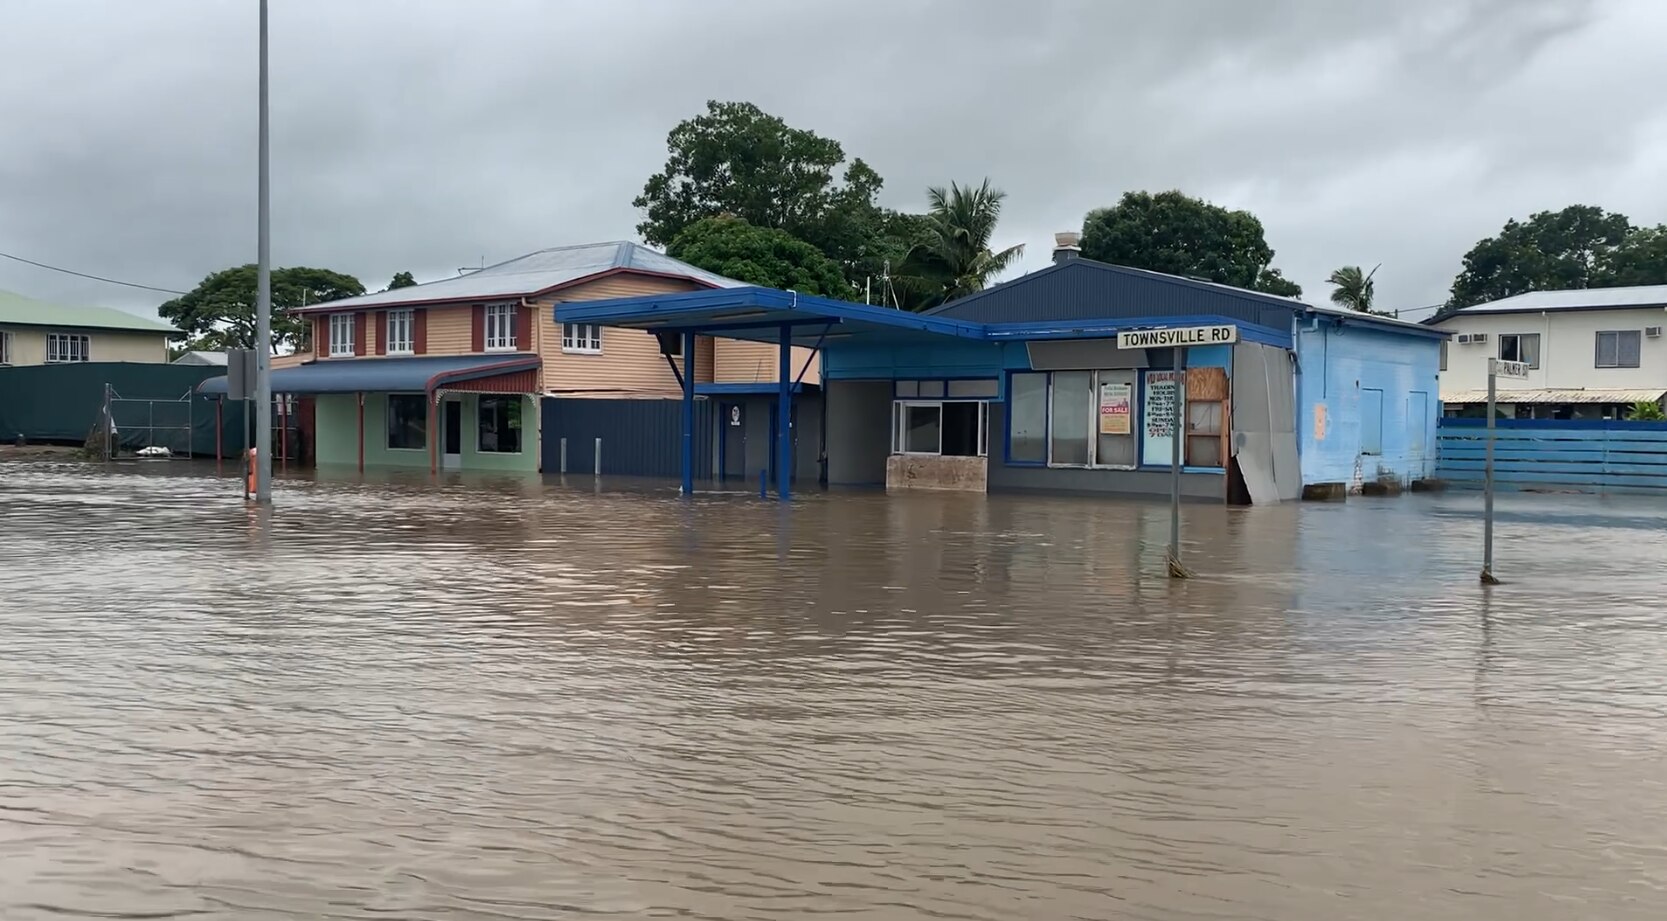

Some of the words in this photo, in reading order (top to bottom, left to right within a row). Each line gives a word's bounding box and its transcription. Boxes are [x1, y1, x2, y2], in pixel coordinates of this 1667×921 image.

[1123, 329, 1205, 346] TOWNSVILLE
[1212, 328, 1230, 341] RD
[1504, 361, 1521, 376] PALMER
